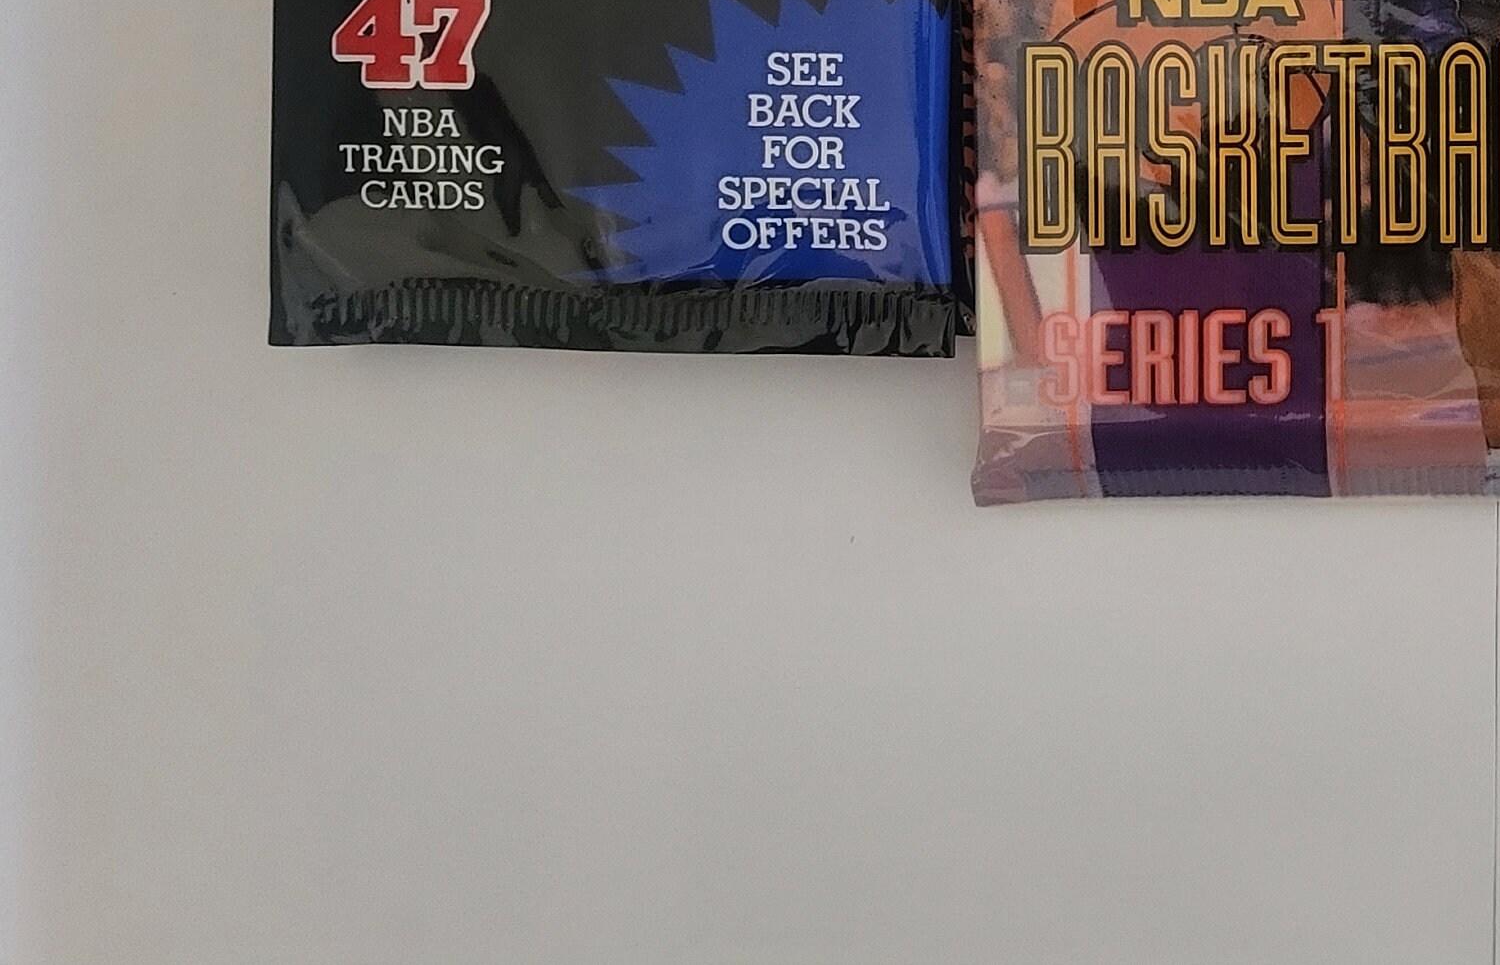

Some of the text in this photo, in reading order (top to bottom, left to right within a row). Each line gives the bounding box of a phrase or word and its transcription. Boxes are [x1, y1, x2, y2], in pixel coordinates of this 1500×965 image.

[767, 52, 844, 87] SEE
[383, 108, 460, 138] NBA
[747, 94, 860, 129] BACK
[339, 144, 504, 175] TRADING
[762, 136, 846, 171] FOR
[360, 180, 485, 211] CARDS
[717, 178, 890, 212] SPECIAL
[722, 218, 888, 251] OFFERS
[1039, 308, 1345, 406] SERIES 1
